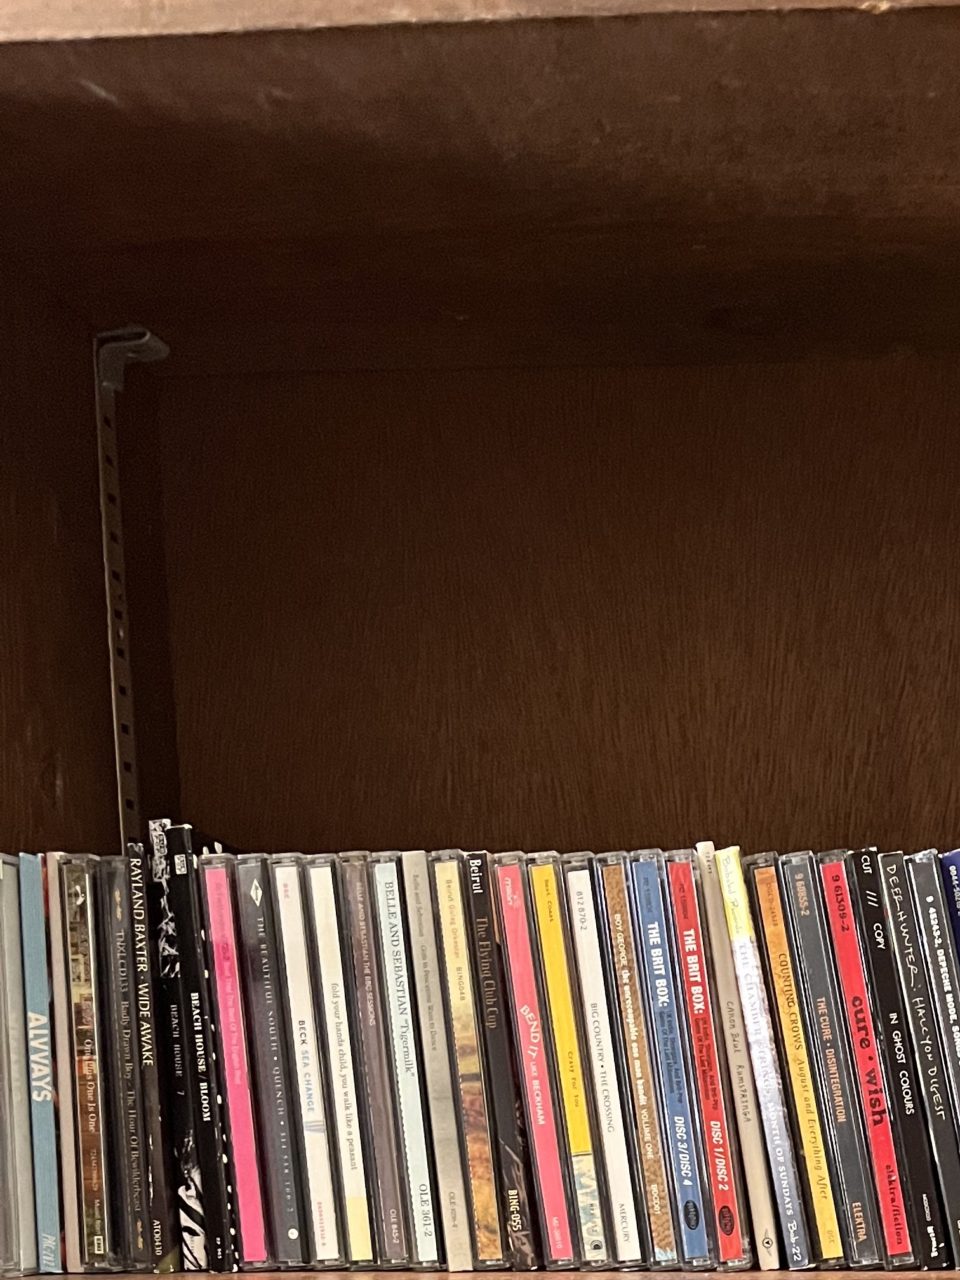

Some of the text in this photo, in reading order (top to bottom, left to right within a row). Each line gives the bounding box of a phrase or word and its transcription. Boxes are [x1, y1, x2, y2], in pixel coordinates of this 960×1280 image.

[384, 881, 397, 918] BELLE
[389, 921, 400, 948] AND
[469, 858, 498, 1029] Beirut The Flying Club Cup
[647, 922, 660, 945] THE
[683, 929, 696, 952] THE
[129, 858, 154, 1066] RAYLAND BAXTER WIDE AWAKE
[391, 949, 408, 1016] SEBASTIAN
[651, 949, 664, 975] BRIT
[687, 956, 701, 982] BRIT
[861, 855, 915, 1115] CUT COPY IN GHOST COLOURS
[655, 979, 668, 1007] BOX:
[691, 986, 705, 1014] BOX:
[832, 875, 887, 1127] 9 61309-2 cure wish
[190, 992, 212, 1122] BEACH HOUSE BLOOM
[297, 1019, 316, 1114] BECK SEA CHANGE
[590, 1003, 615, 1132] BIG COUNTRY THE CROSSING
[778, 953, 828, 1200] COUNTING CROWS August and Everything After
[418, 1183, 433, 1237] OLE 361-2
[618, 1203, 631, 1242] MERCURY
[852, 1202, 867, 1242] ELEKTRA
